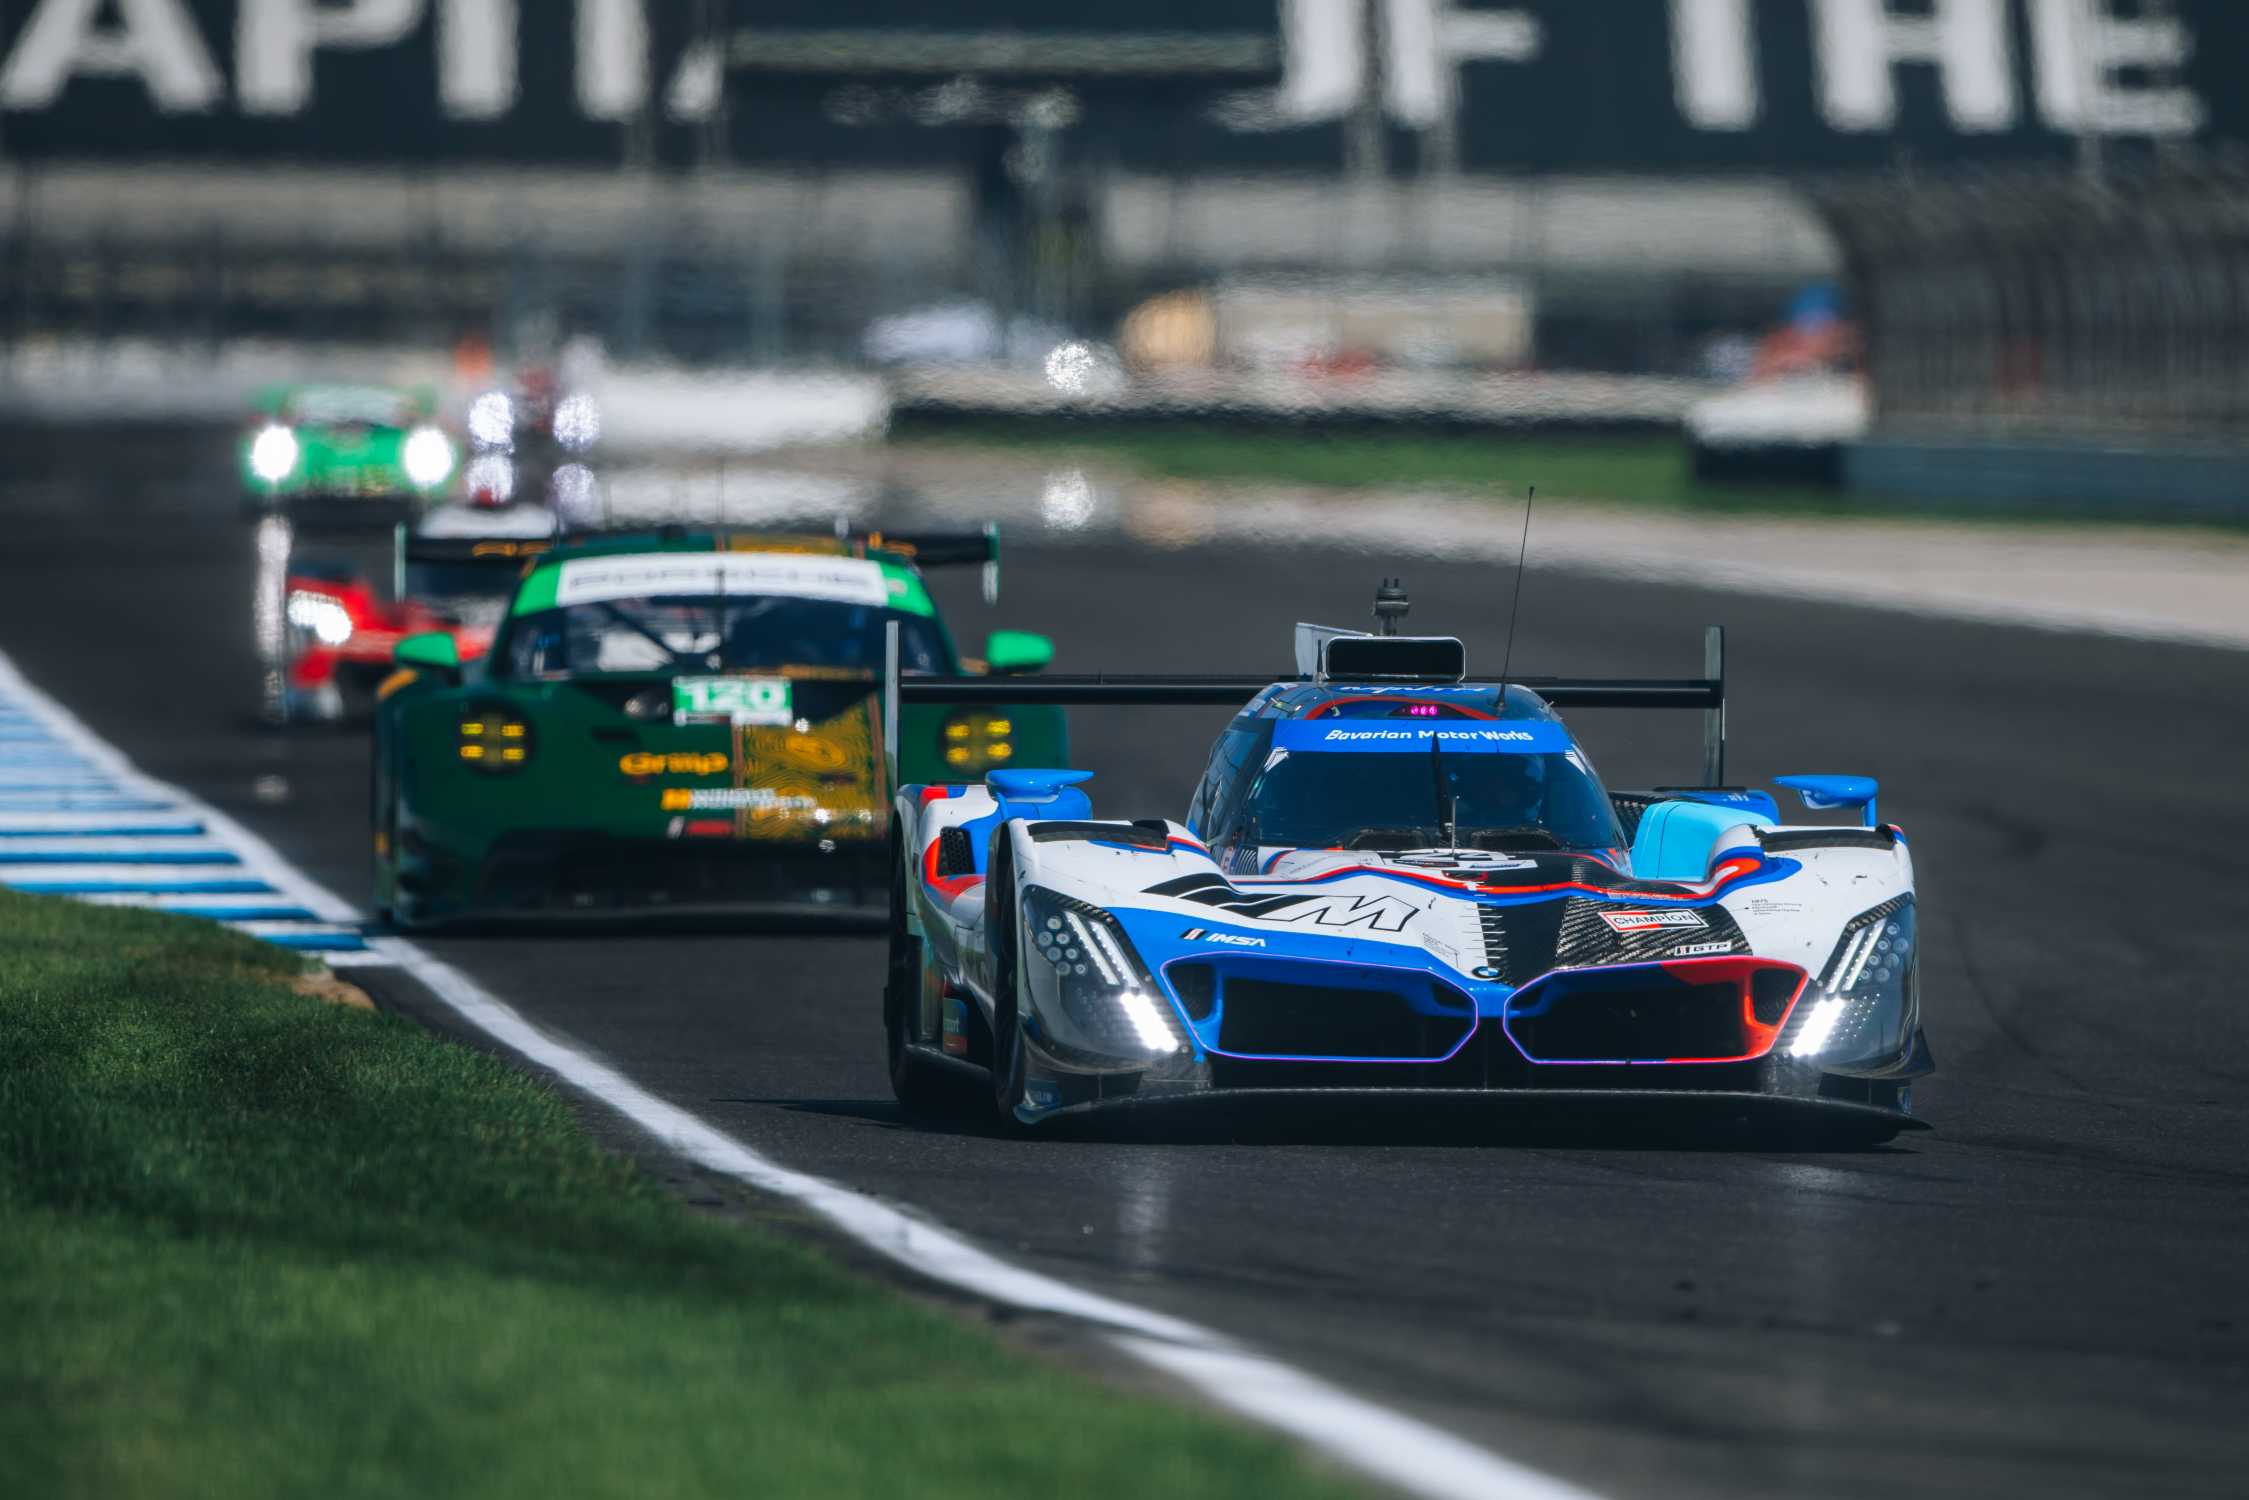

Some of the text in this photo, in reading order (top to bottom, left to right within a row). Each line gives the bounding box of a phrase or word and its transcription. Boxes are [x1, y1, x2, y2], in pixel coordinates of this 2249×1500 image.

[682, 680, 786, 712] 120
[1325, 729, 1534, 741] Bavarian Motor Works
[1613, 913, 1696, 926] CHAMPION
[1205, 932, 1267, 948] IMSA
[1692, 943, 1729, 953] GTP
